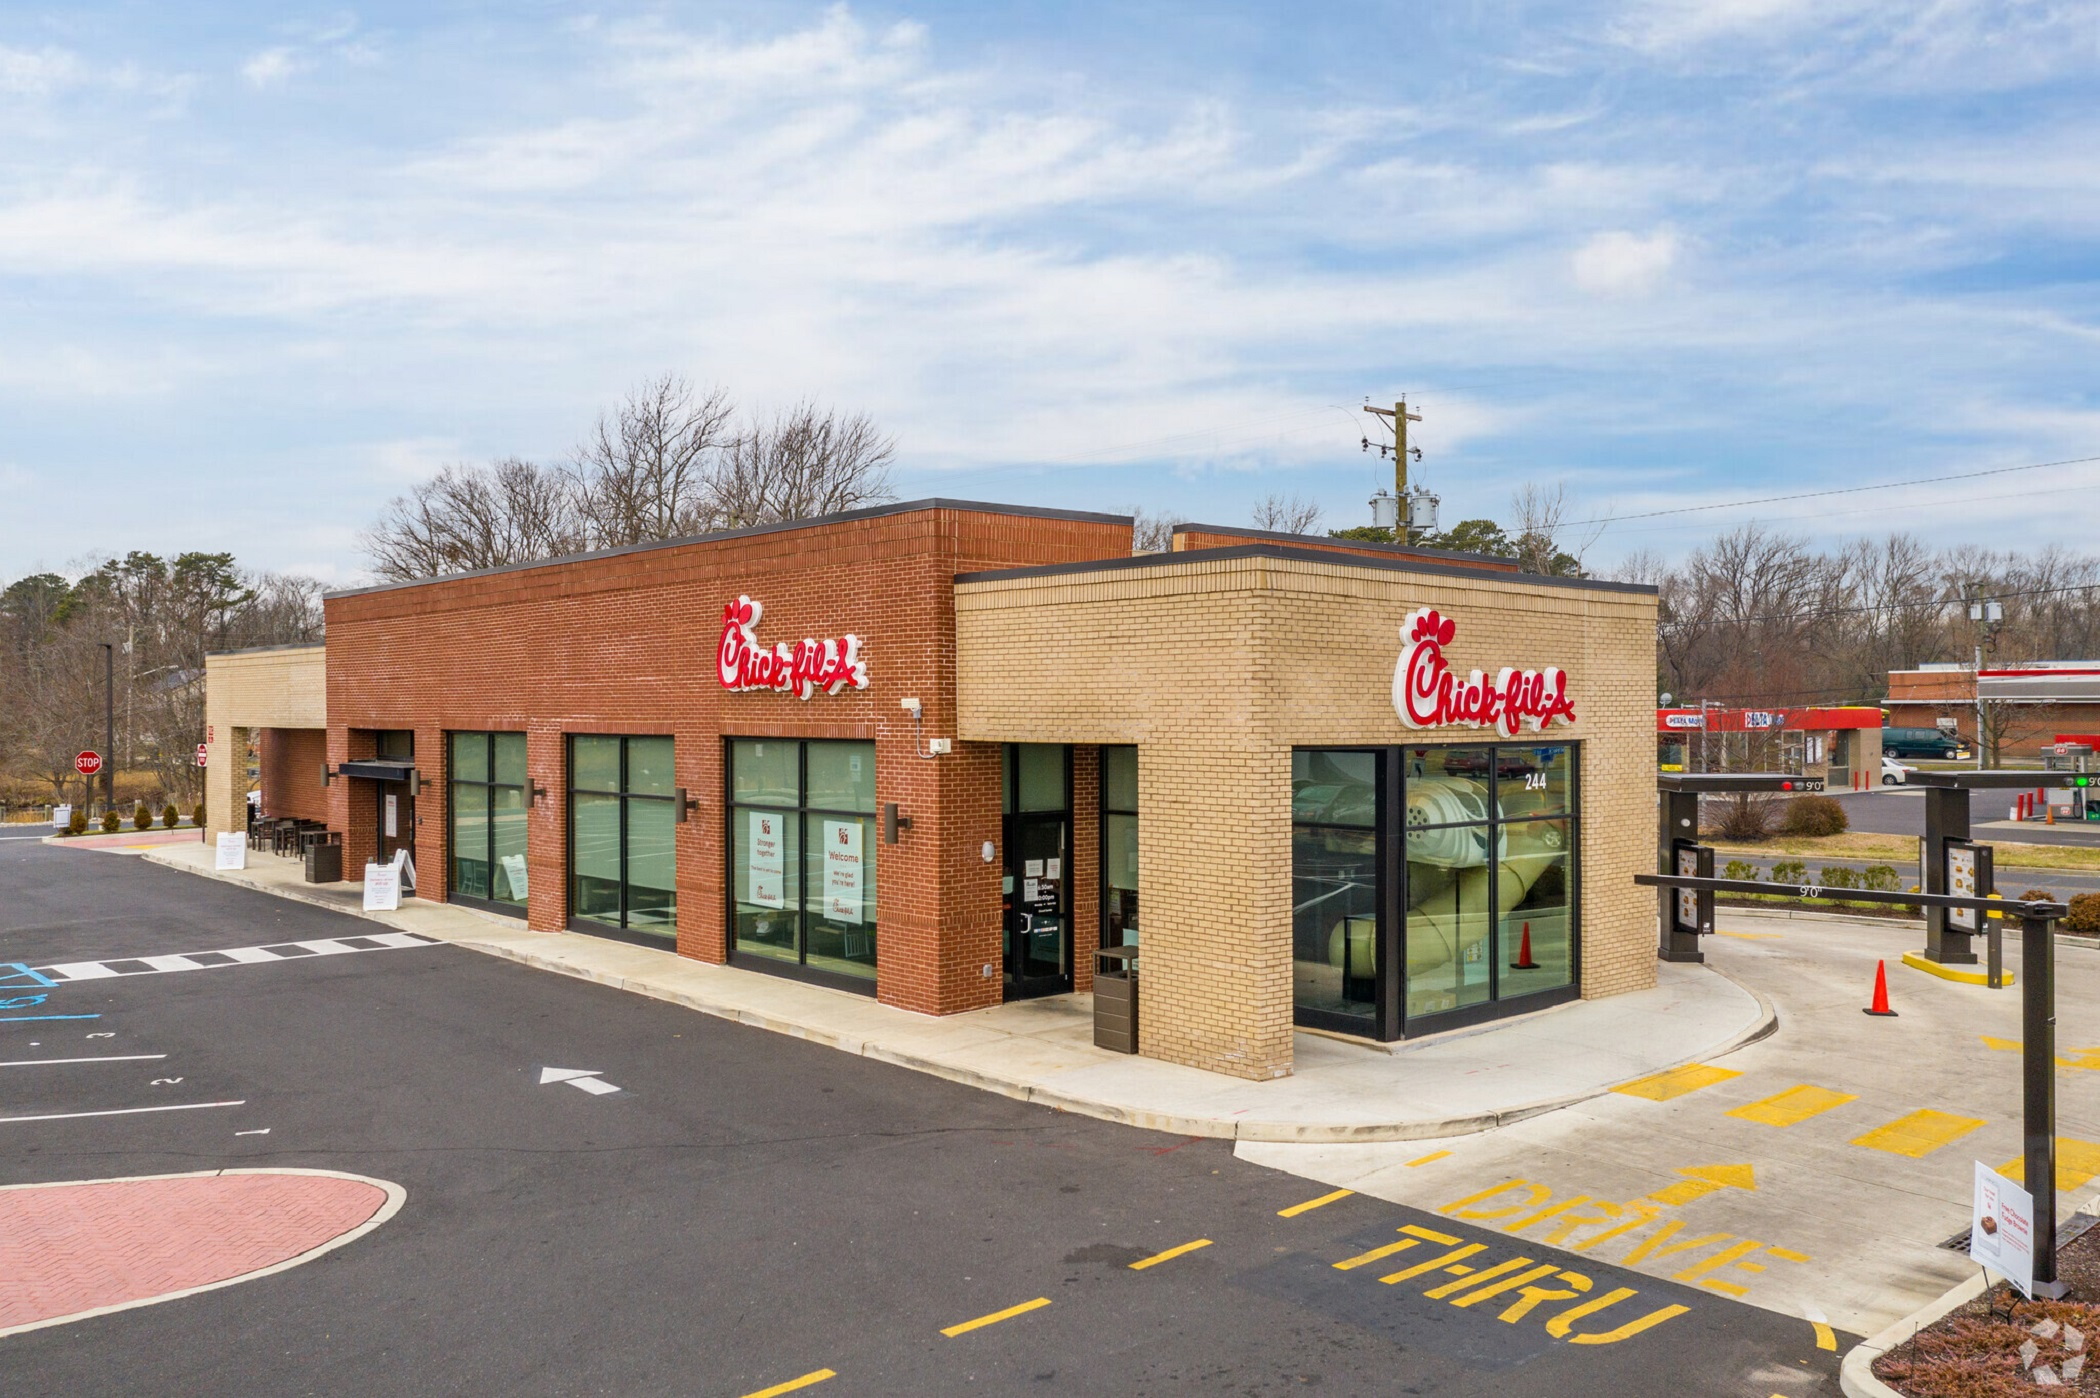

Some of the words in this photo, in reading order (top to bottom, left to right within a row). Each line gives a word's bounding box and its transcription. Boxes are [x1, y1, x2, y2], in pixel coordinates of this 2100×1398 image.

[716, 598, 864, 698] Chick-fil-A
[1402, 609, 1577, 735] Chick-fil-A
[77, 757, 100, 768] STOP
[1525, 772, 1547, 791] 244
[828, 850, 859, 863] Welcome
[1800, 886, 1822, 898] 9'0"
[150, 1077, 184, 1086] 2
[1437, 1178, 1812, 1297] DRIVE
[1331, 1224, 1691, 1345] THRU
